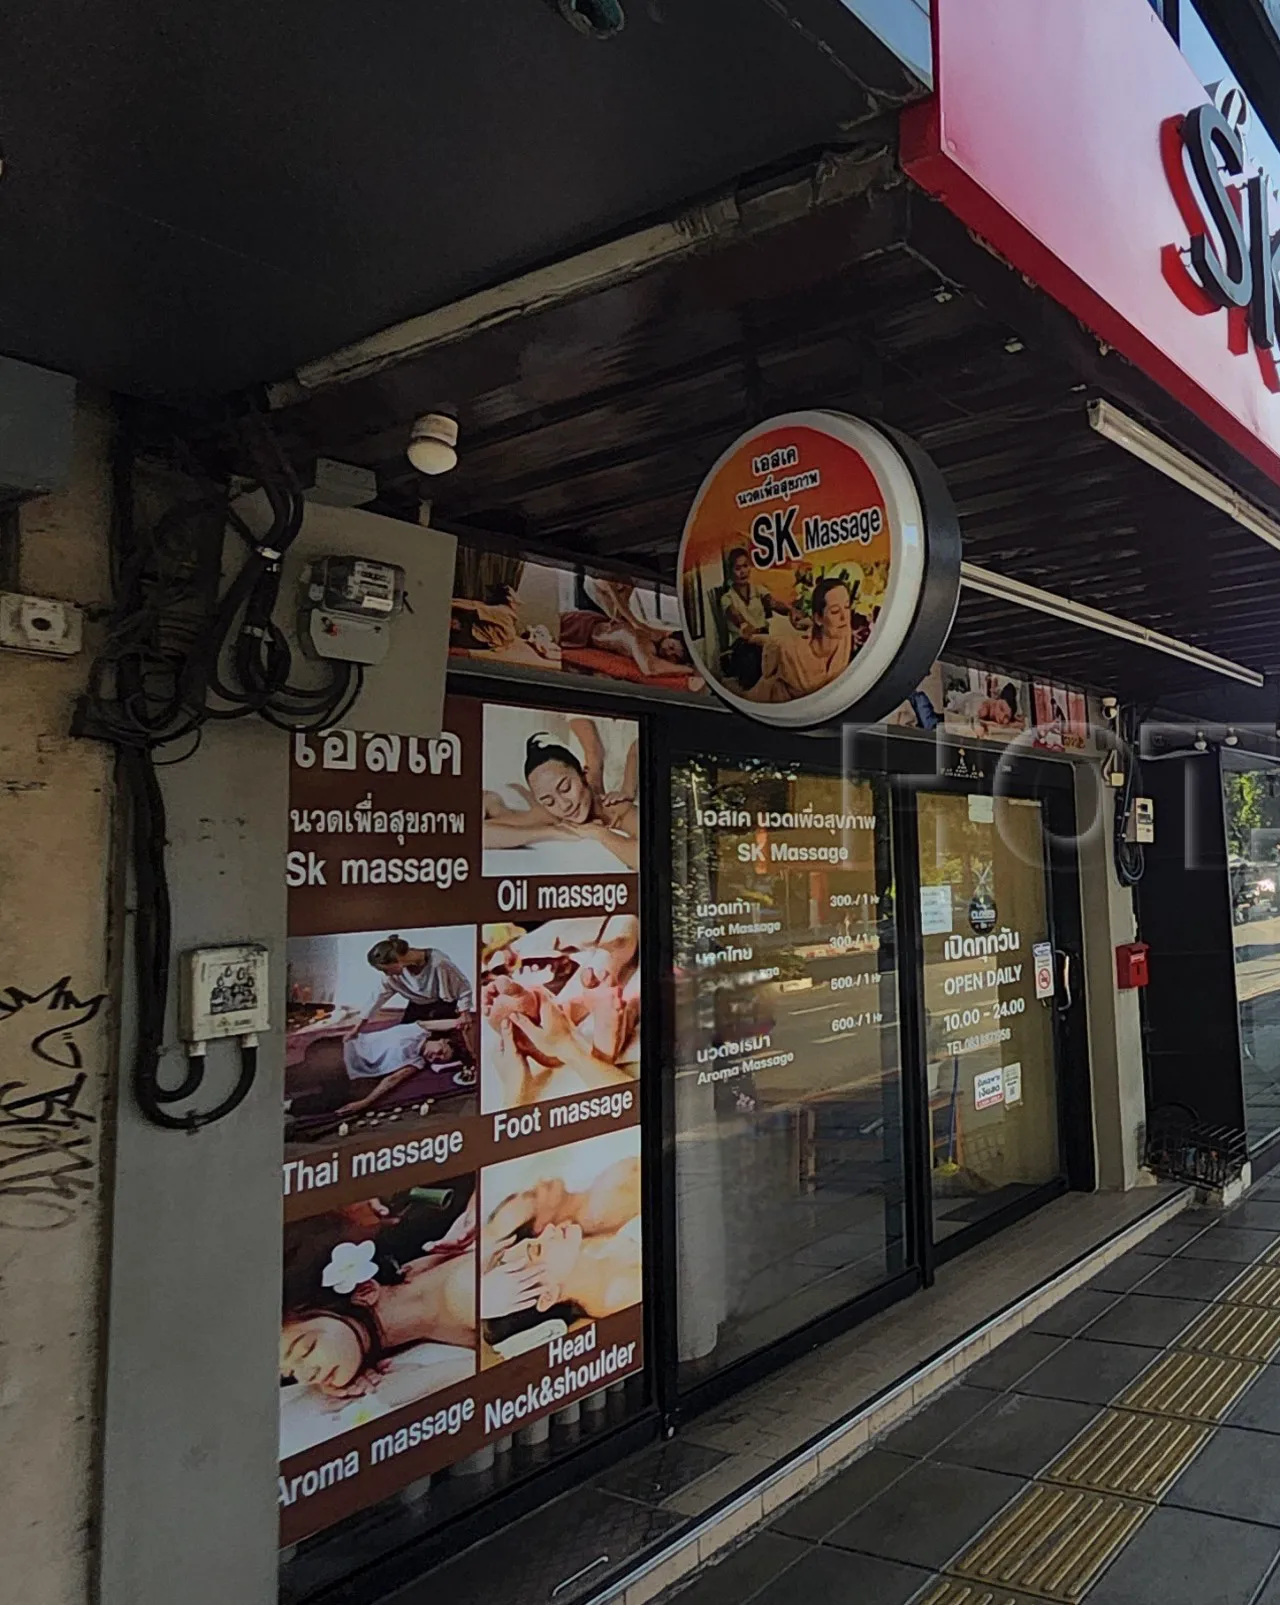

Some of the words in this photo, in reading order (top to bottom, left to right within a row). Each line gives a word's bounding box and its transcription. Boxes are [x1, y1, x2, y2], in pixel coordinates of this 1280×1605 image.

[754, 447, 797, 475] เอสเค
[737, 475, 819, 507] นวดเพื่อสุขภาพ
[753, 507, 800, 568] SK
[804, 508, 881, 552] Massage
[290, 792, 466, 846] นวดเพื่อสุขภาพ
[697, 808, 752, 828] เอสเค
[757, 802, 877, 835] นวดเพื่อสุขภาพ
[286, 850, 328, 887] Sk
[341, 857, 470, 889] massage
[737, 843, 766, 862] SK
[771, 843, 849, 864] Massage
[497, 880, 529, 912] Oil
[537, 881, 629, 913] massage
[697, 924, 726, 939] Foot
[728, 921, 781, 936] Massage
[944, 926, 1020, 964] เปิดทุกวัน
[944, 971, 983, 996] OPEN
[986, 964, 1022, 988] DAILY
[943, 1008, 981, 1033] 10.00
[993, 997, 1026, 1020] 24.00
[696, 1066, 740, 1086] Aroma
[741, 1052, 795, 1074] Massage
[493, 1106, 543, 1143] Foot
[548, 1089, 634, 1129] massage
[281, 1152, 339, 1196] Thai
[351, 1128, 464, 1178] massage
[547, 1322, 598, 1369] Head
[484, 1338, 637, 1436] Neck&shoulder
[277, 1450, 360, 1507] Aroma
[370, 1394, 476, 1467] massage
